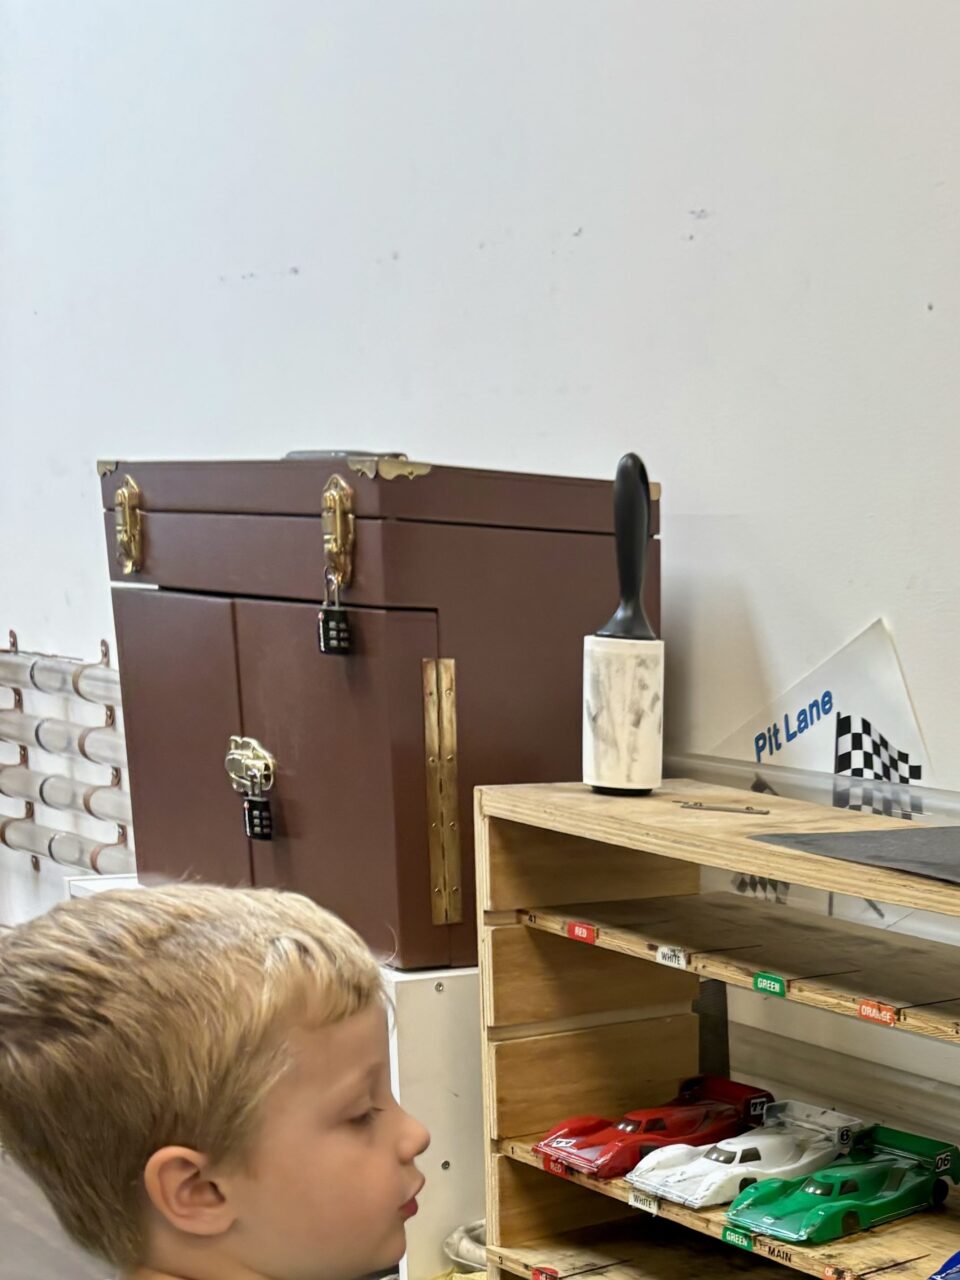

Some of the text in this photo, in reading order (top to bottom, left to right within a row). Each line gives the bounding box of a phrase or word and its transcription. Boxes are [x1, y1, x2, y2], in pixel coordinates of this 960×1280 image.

[755, 690, 833, 764] Pit Lane
[574, 926, 588, 938] RED
[661, 951, 681, 966] WHITE
[757, 977, 780, 993] GREEN
[633, 1194, 652, 1209] WHITE
[726, 1231, 748, 1247] GREEN
[767, 1245, 792, 1263] MAIN
